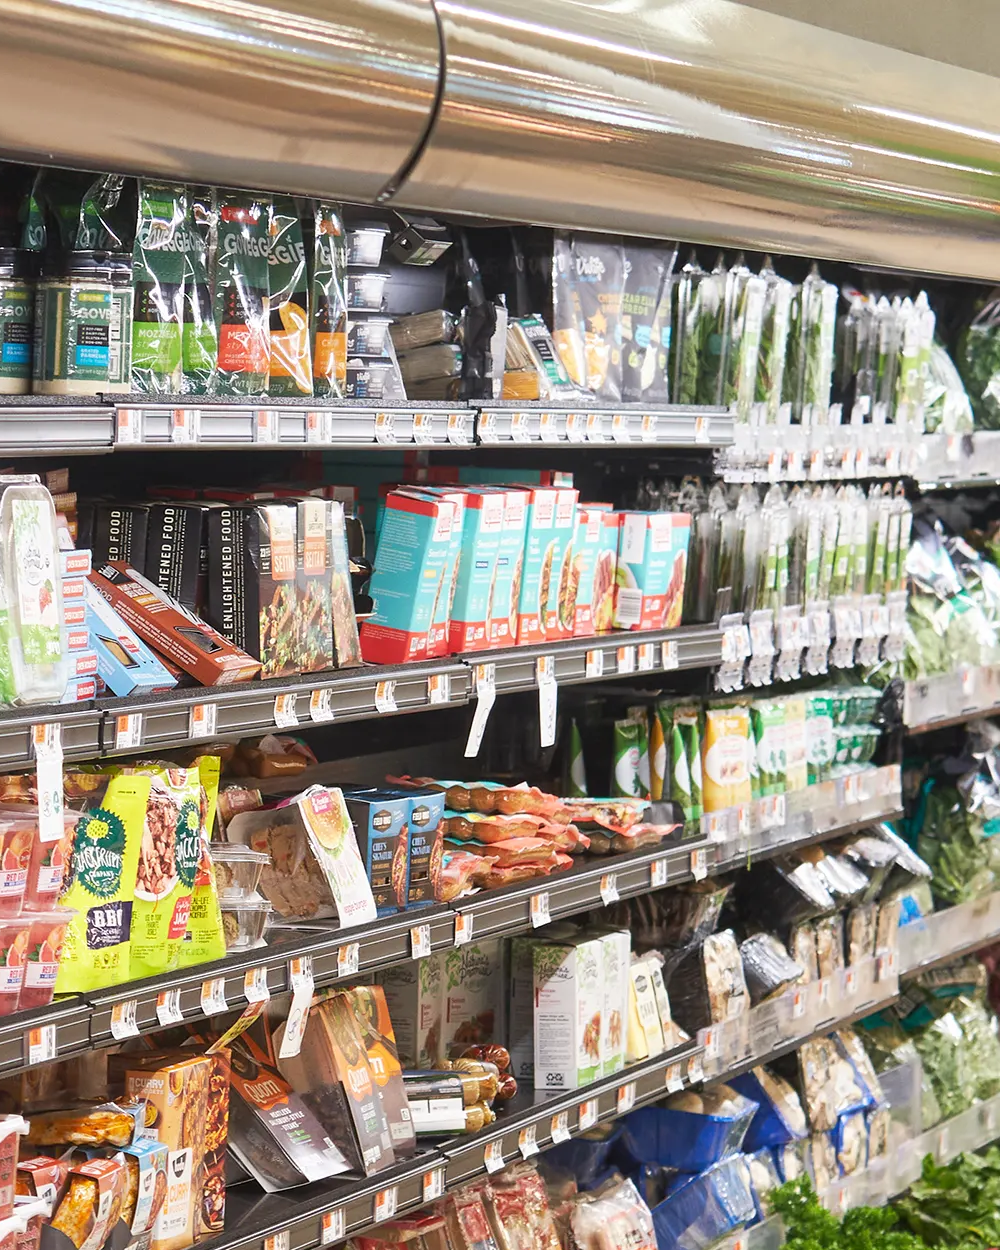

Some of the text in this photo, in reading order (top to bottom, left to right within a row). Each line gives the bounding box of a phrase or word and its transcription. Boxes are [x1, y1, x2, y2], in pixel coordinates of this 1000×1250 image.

[110, 511, 122, 542] FOOD
[163, 508, 175, 539] FOOD
[221, 509, 234, 632] ENLIGHTENED FOOD
[75, 846, 123, 873] JACKFRUIT
[135, 1078, 165, 1089] CURRY
[243, 1078, 283, 1105] Quorn
